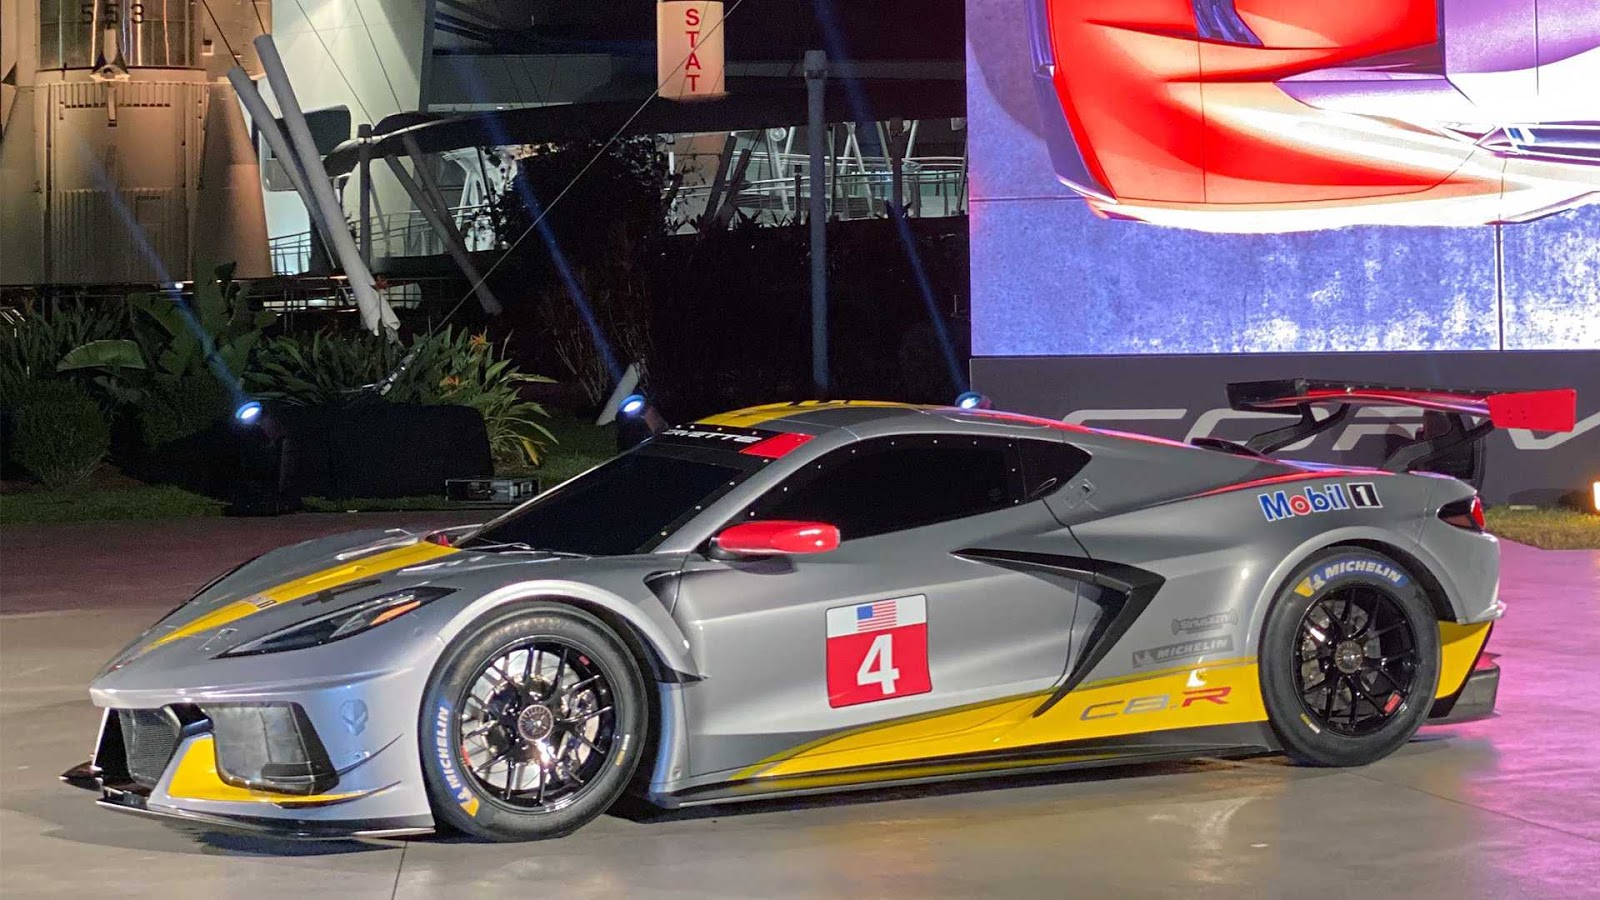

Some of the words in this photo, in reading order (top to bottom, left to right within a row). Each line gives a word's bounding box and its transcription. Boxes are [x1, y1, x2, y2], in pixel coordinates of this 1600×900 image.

[685, 8, 702, 92] STAT
[1258, 485, 1349, 521] Mobil
[1353, 485, 1375, 507] 1
[1325, 560, 1402, 583] MICHELIN
[857, 633, 900, 695] 4
[1156, 638, 1228, 660] MICHELIN
[1080, 686, 1232, 721] C8.R
[436, 706, 462, 790] MICHELIN
